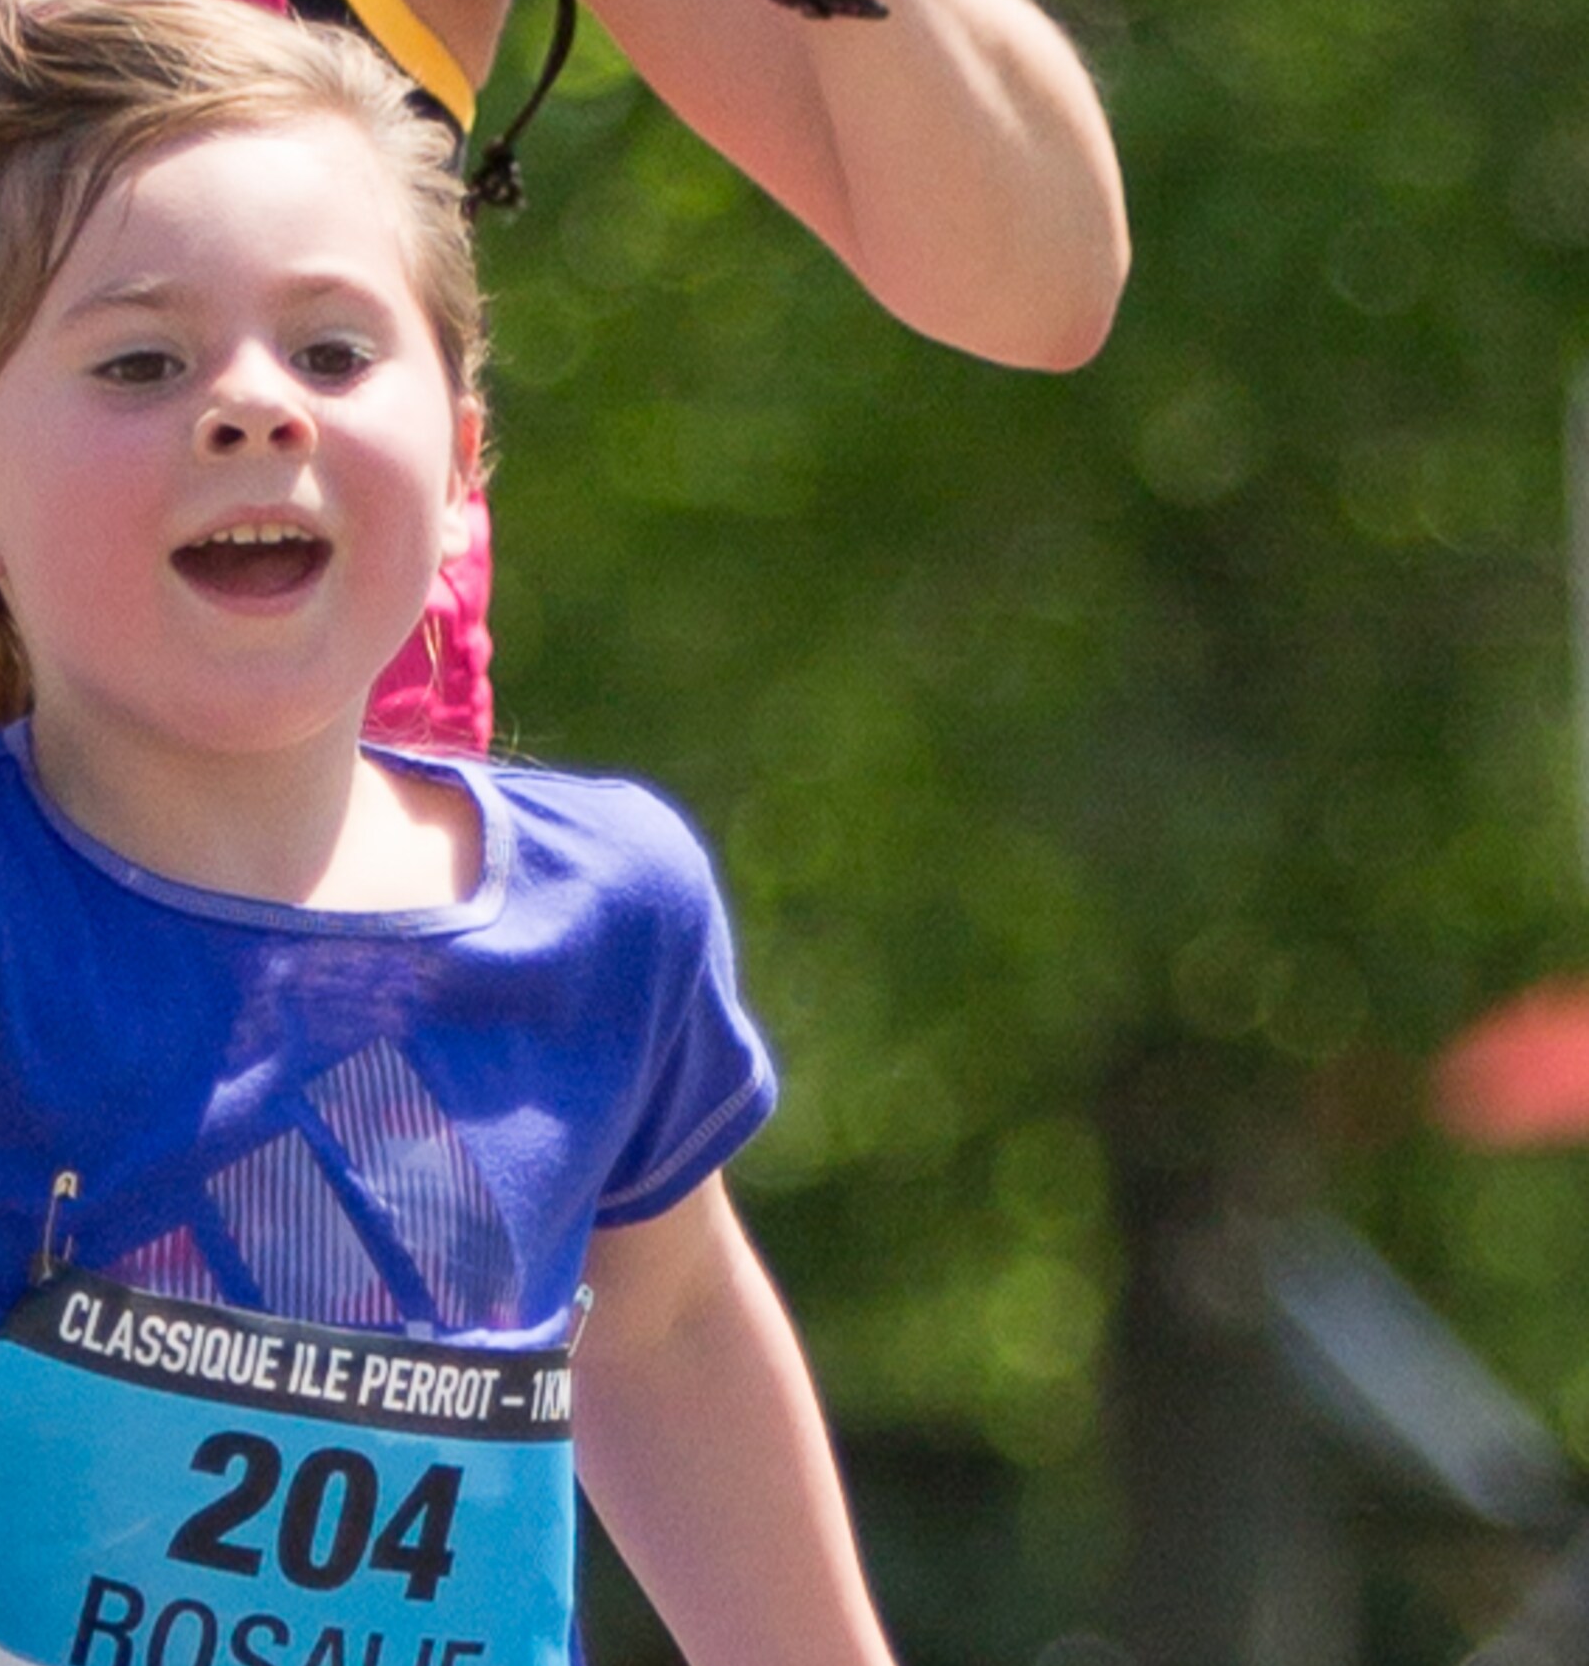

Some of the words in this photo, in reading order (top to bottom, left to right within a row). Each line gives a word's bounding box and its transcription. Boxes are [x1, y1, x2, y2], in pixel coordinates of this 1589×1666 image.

[58, 1290, 284, 1392] CLASSIQUE
[286, 1341, 354, 1403] ILE
[357, 1353, 501, 1421] PERROT
[165, 1429, 464, 1603] 204
